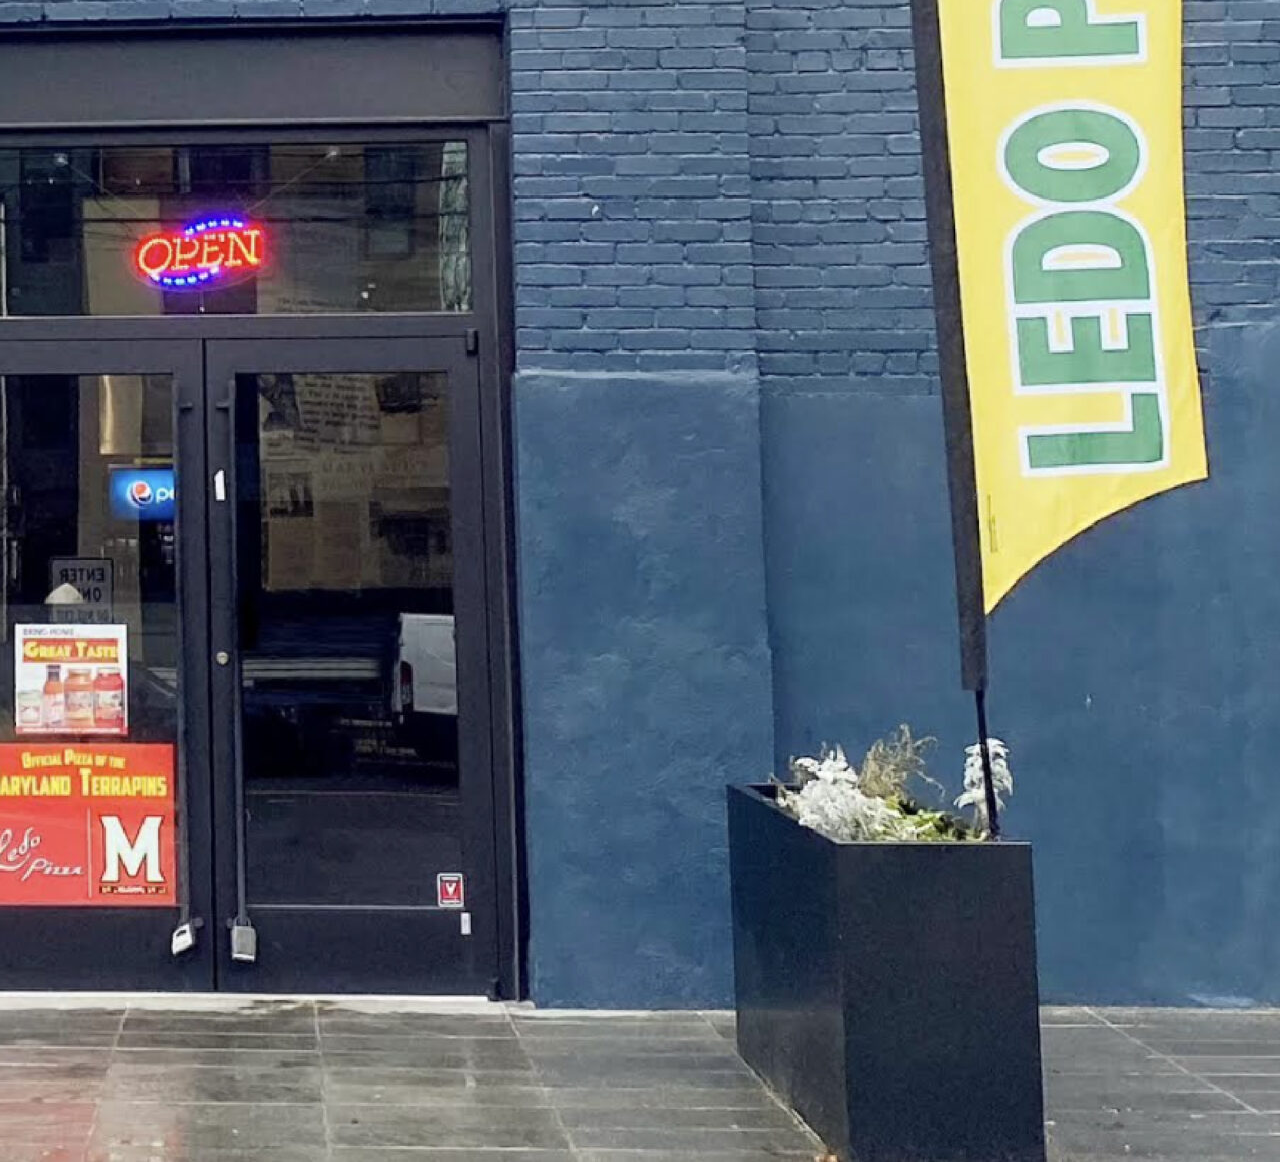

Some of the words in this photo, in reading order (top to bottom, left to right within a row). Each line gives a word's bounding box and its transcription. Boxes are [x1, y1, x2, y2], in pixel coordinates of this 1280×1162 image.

[137, 229, 262, 272] OPEN
[1000, 102, 1168, 473] LEDO
[23, 641, 73, 658] GREAT
[75, 641, 117, 658] TASTE
[64, 749, 94, 766] PIZZA
[80, 767, 167, 797] TERRAPINS
[99, 814, 166, 883] M
